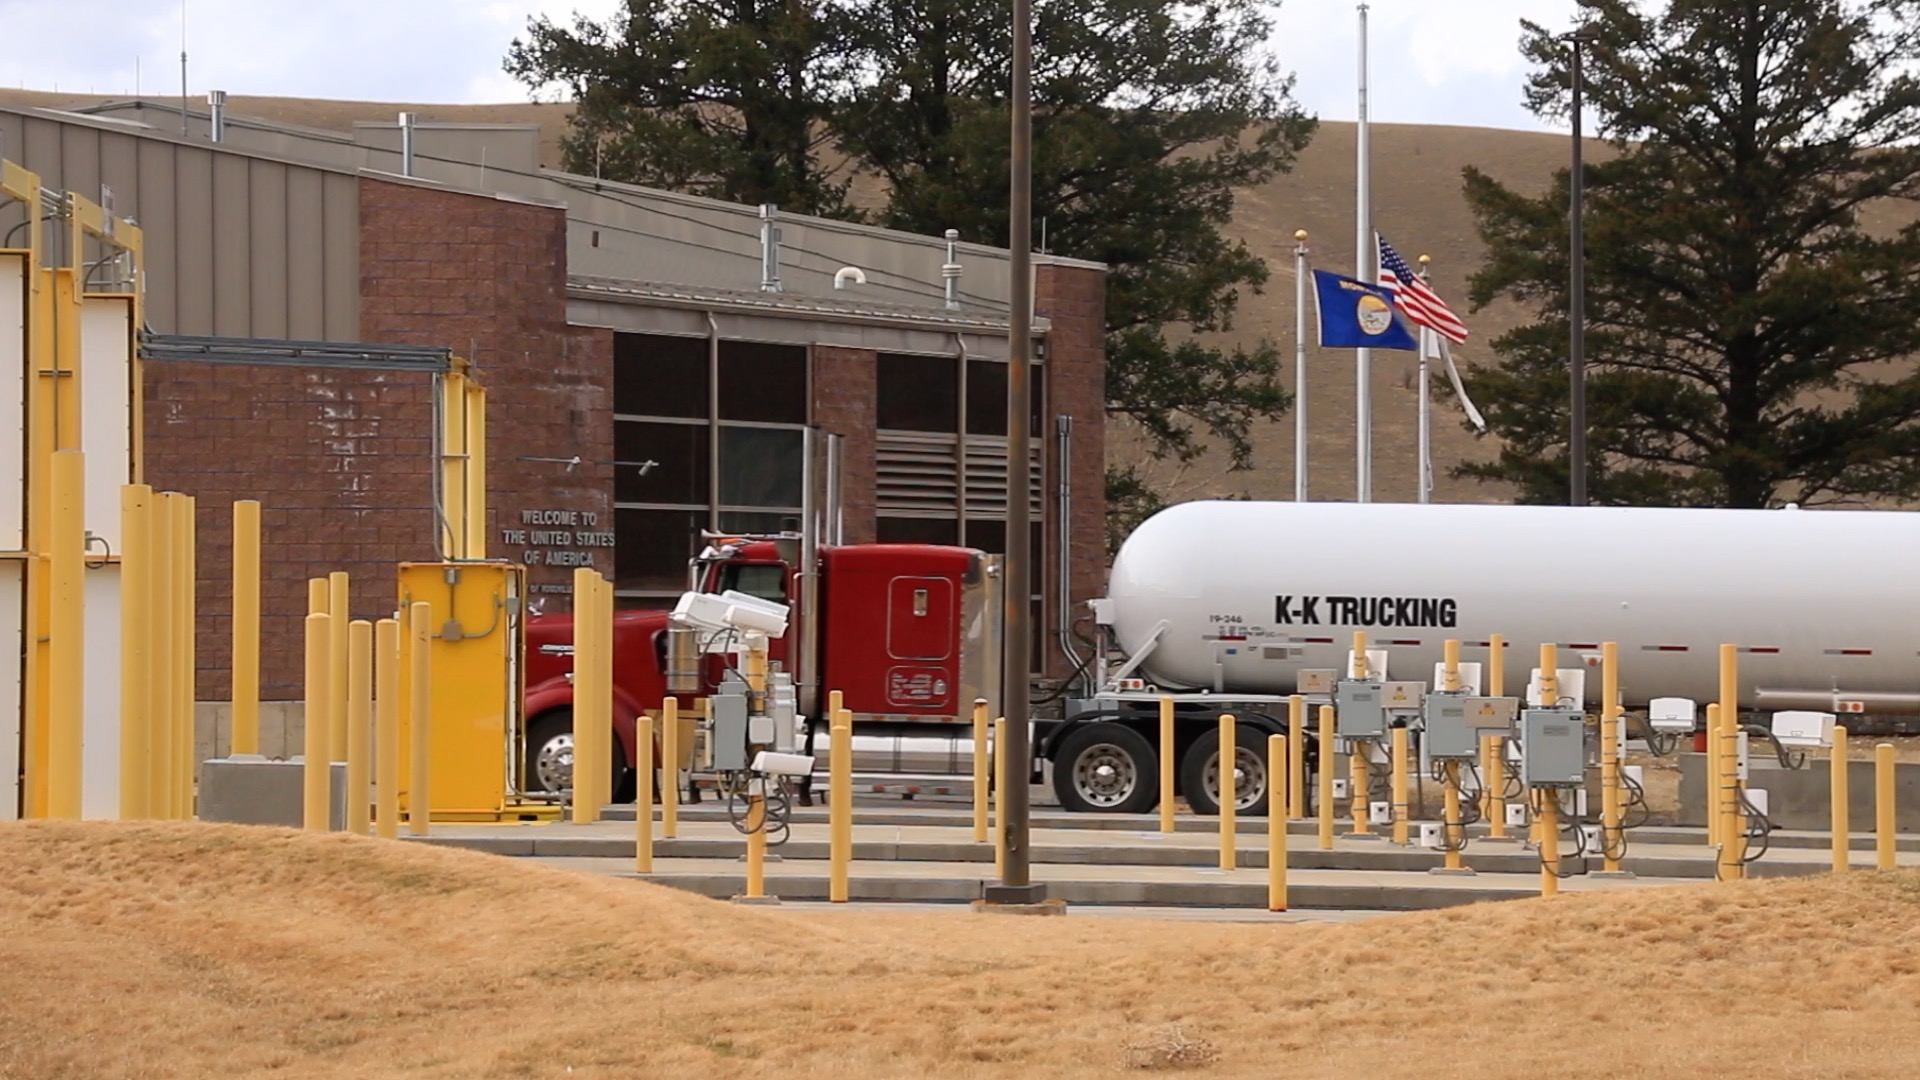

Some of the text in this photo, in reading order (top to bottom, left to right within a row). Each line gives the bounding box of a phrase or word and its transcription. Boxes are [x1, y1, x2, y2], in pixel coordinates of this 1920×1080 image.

[522, 510, 597, 526] WELCOME TO
[503, 529, 615, 546] THE UNITED STATES
[524, 550, 594, 566] OF AMERICA
[1209, 614, 1243, 623] 19-246
[1275, 595, 1457, 627] K-K TRUCKING
